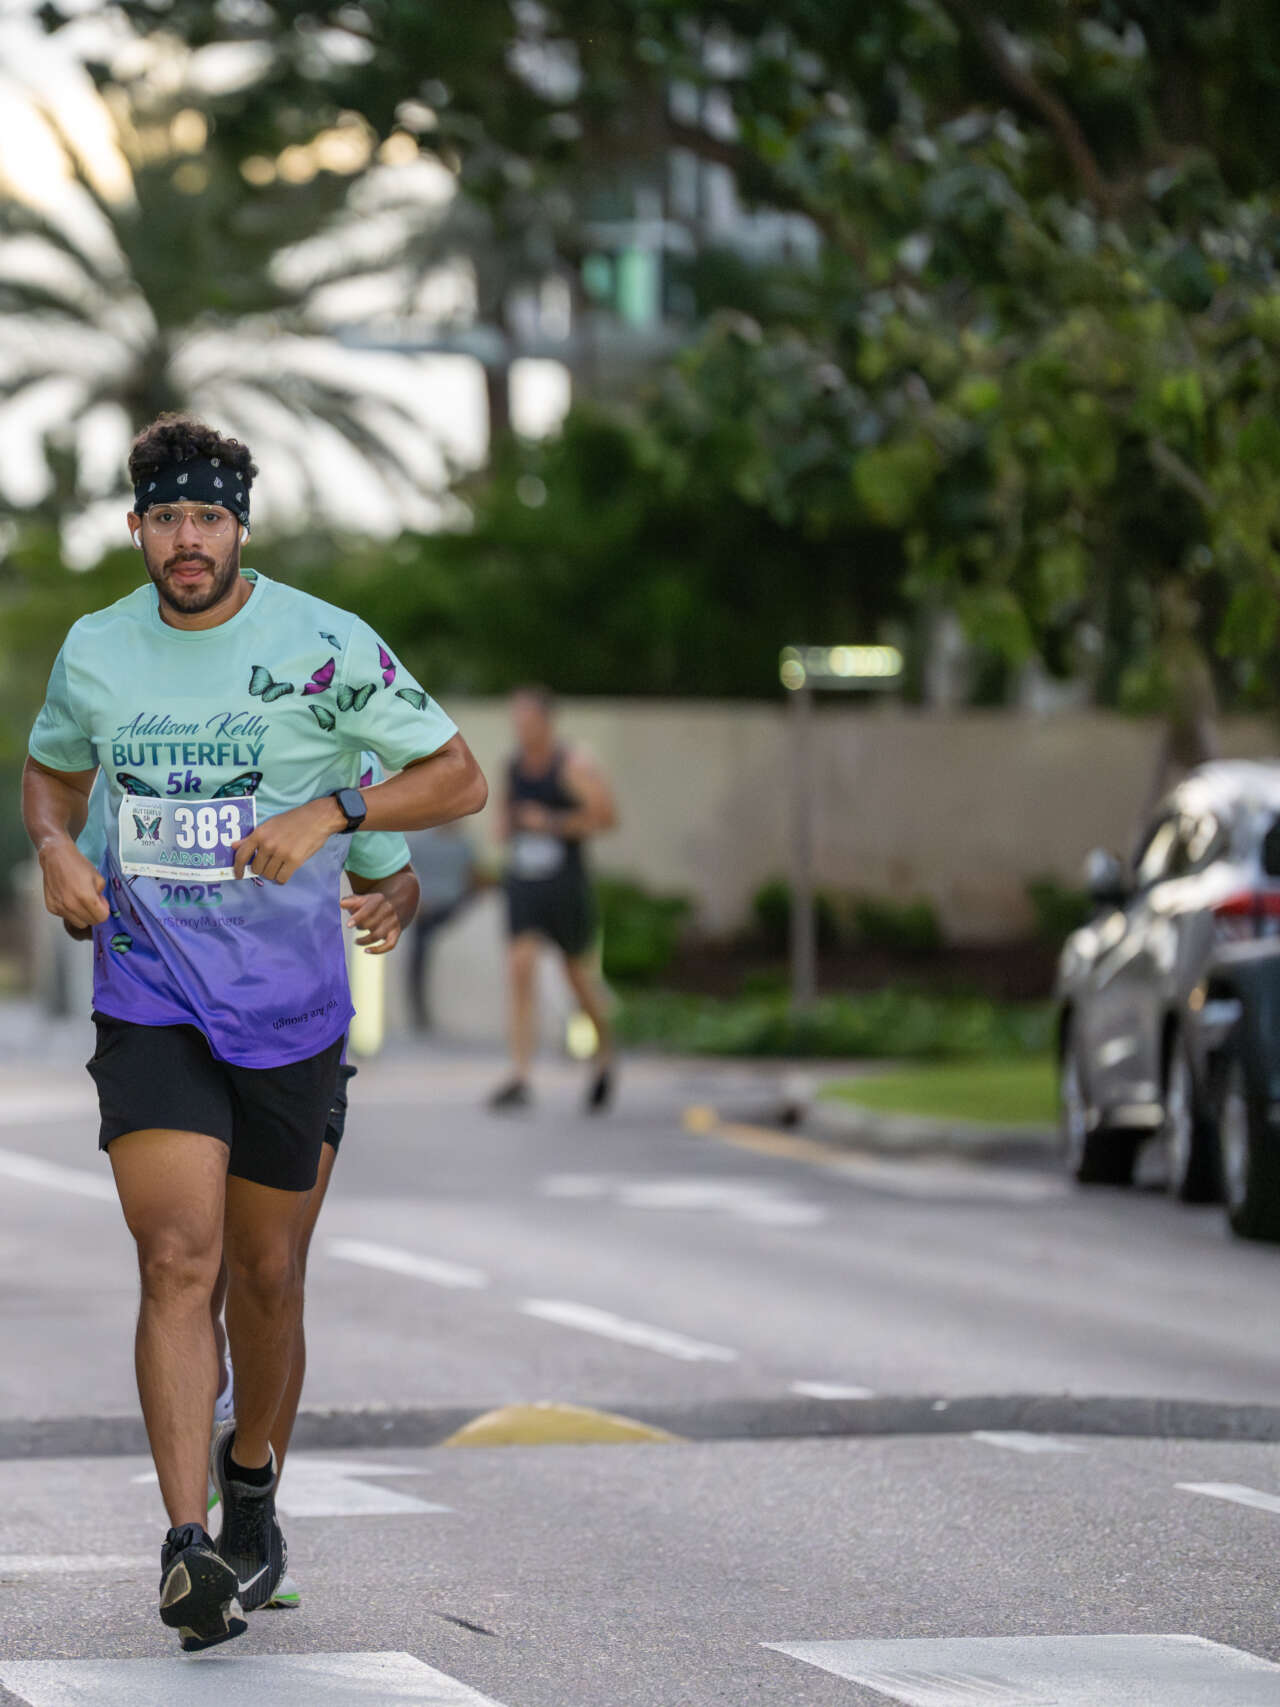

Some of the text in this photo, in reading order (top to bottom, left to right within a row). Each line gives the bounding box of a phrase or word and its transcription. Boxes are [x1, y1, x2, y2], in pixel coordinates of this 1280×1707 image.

[111, 711, 270, 747] Addison Kelly
[111, 742, 265, 767] BUTTERFLY
[166, 769, 202, 795] 5k
[174, 804, 242, 849] 383
[159, 850, 216, 866] AARON
[160, 883, 223, 908] 2025
